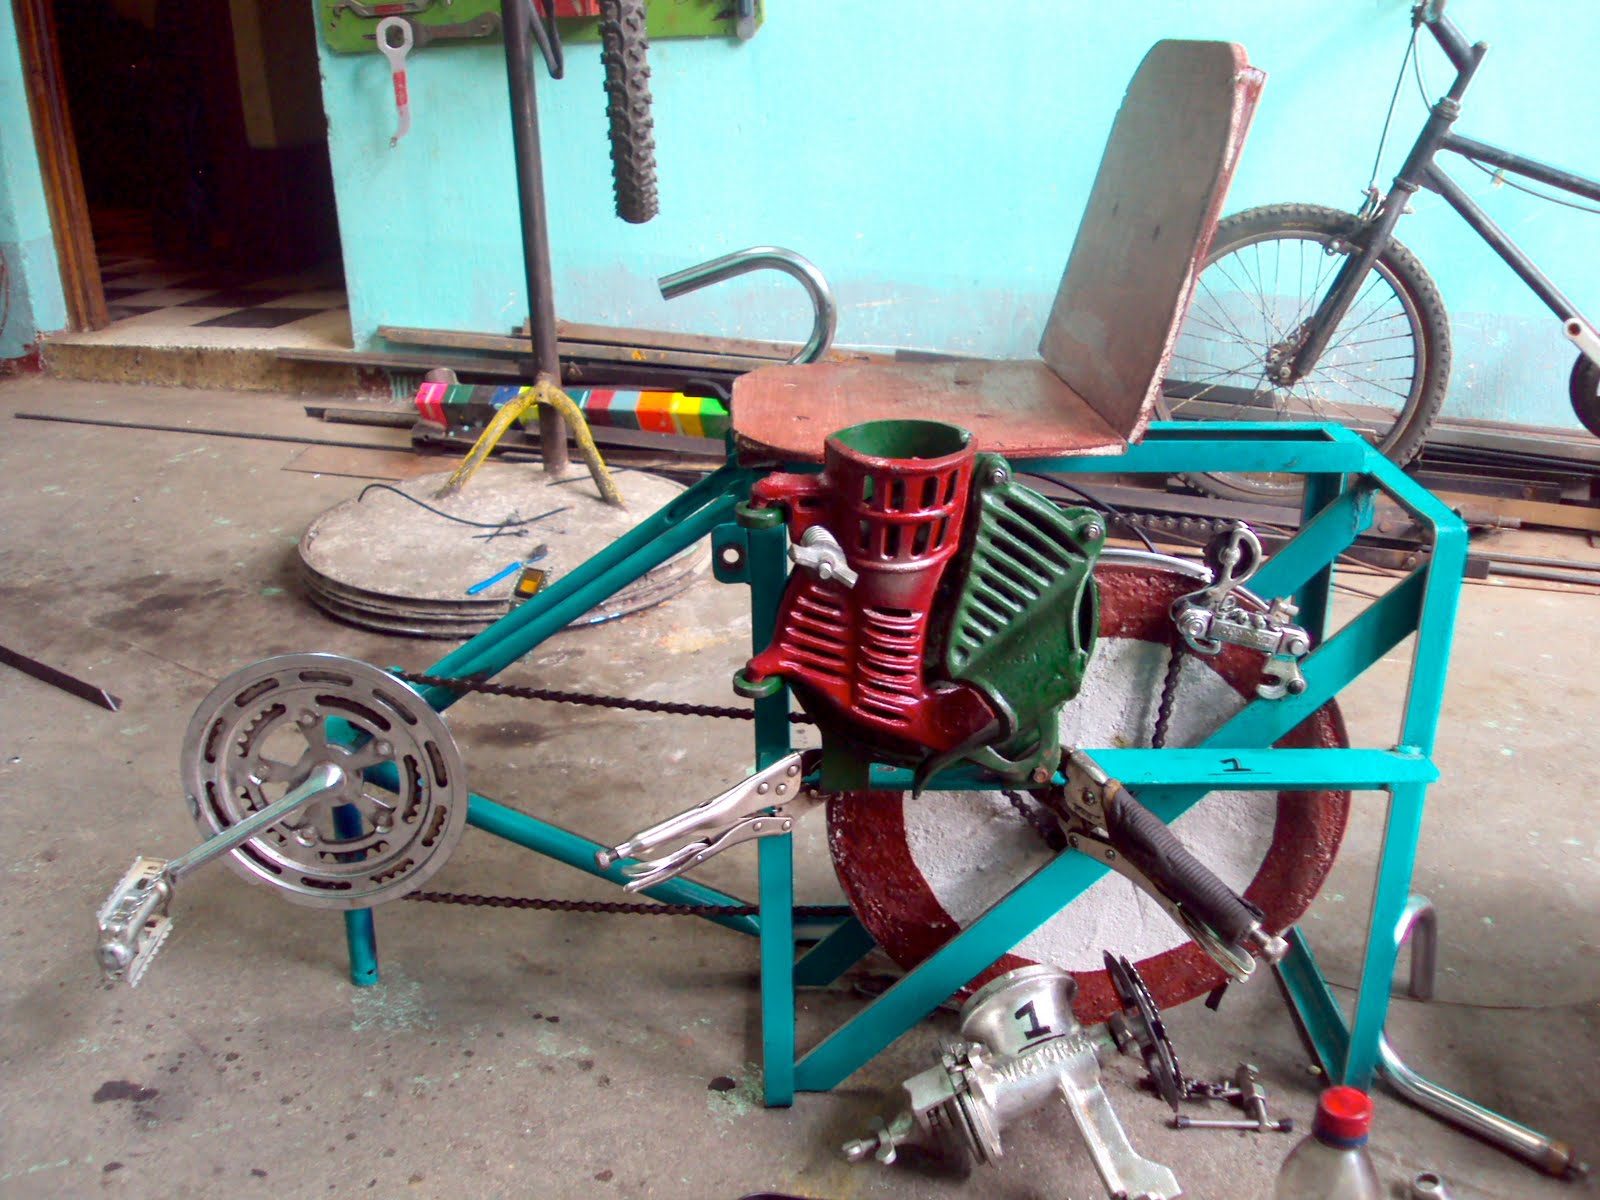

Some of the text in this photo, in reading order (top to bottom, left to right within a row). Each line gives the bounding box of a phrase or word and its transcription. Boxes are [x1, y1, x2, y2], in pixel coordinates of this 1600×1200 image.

[1219, 757, 1252, 772] 1
[1015, 1000, 1051, 1039] 1
[999, 1036, 1097, 1082] VICTORIA
